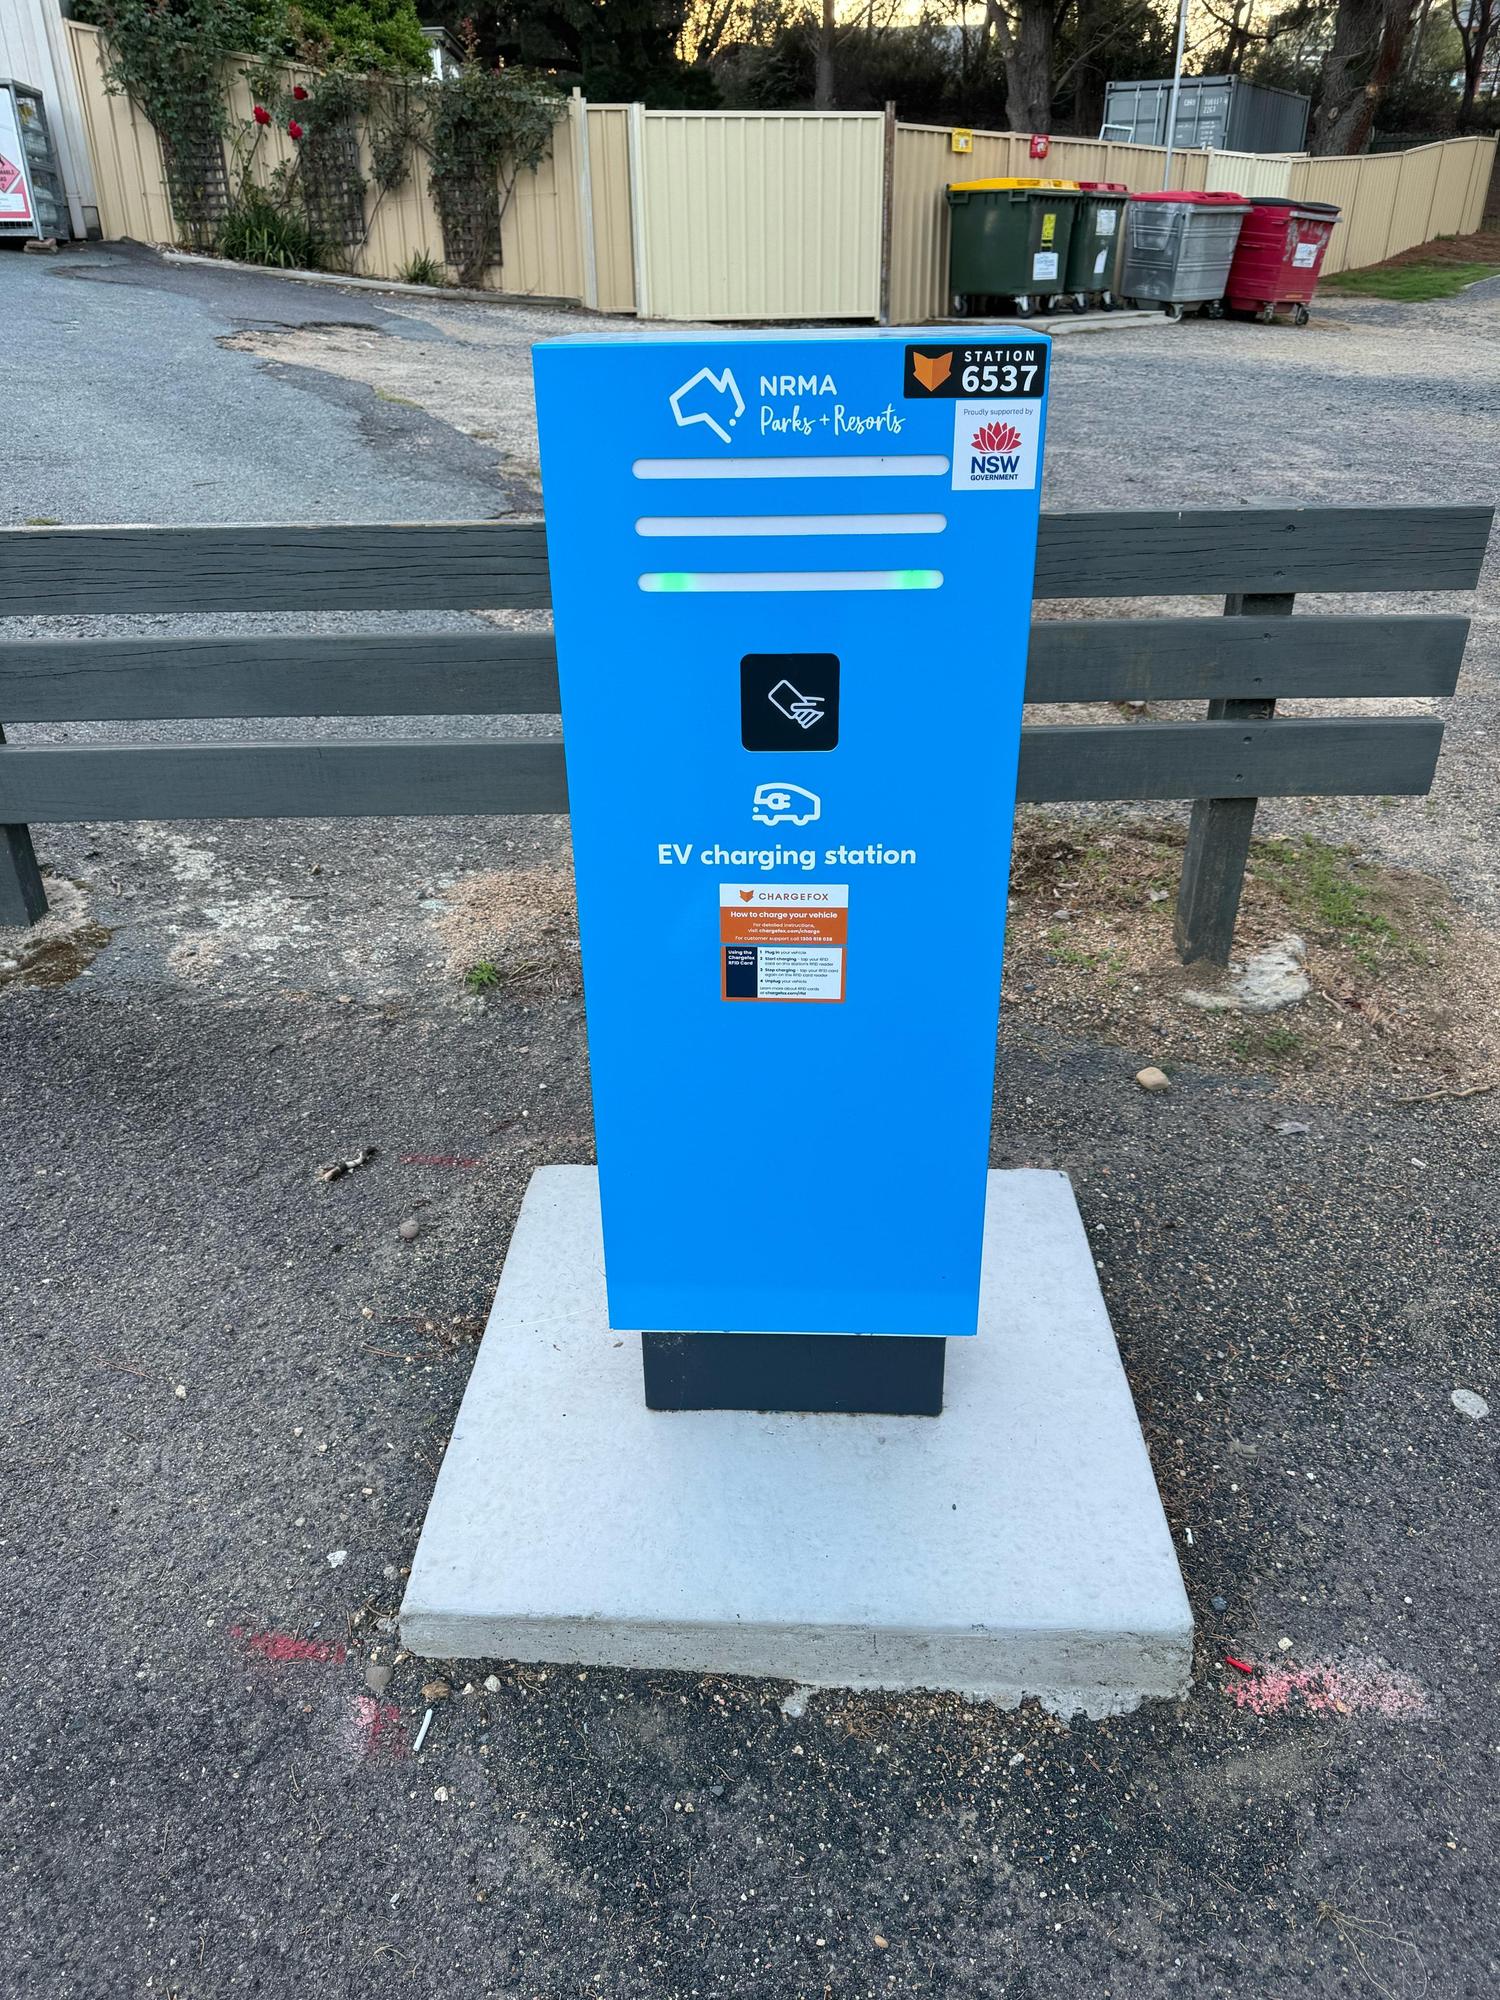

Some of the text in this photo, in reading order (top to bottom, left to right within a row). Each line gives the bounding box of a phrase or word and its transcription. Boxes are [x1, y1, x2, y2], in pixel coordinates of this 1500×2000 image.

[964, 350, 1035, 362] STATION
[760, 374, 837, 396] NRMA
[962, 364, 1038, 392] 6537
[760, 403, 906, 436] Parks + Resorts
[990, 408, 1024, 416] supported
[1025, 408, 1034, 416] by
[970, 456, 1020, 474] NSW
[658, 843, 917, 871] EV charging station
[758, 892, 829, 901] CHARGEFOX
[758, 912, 788, 920] charge
